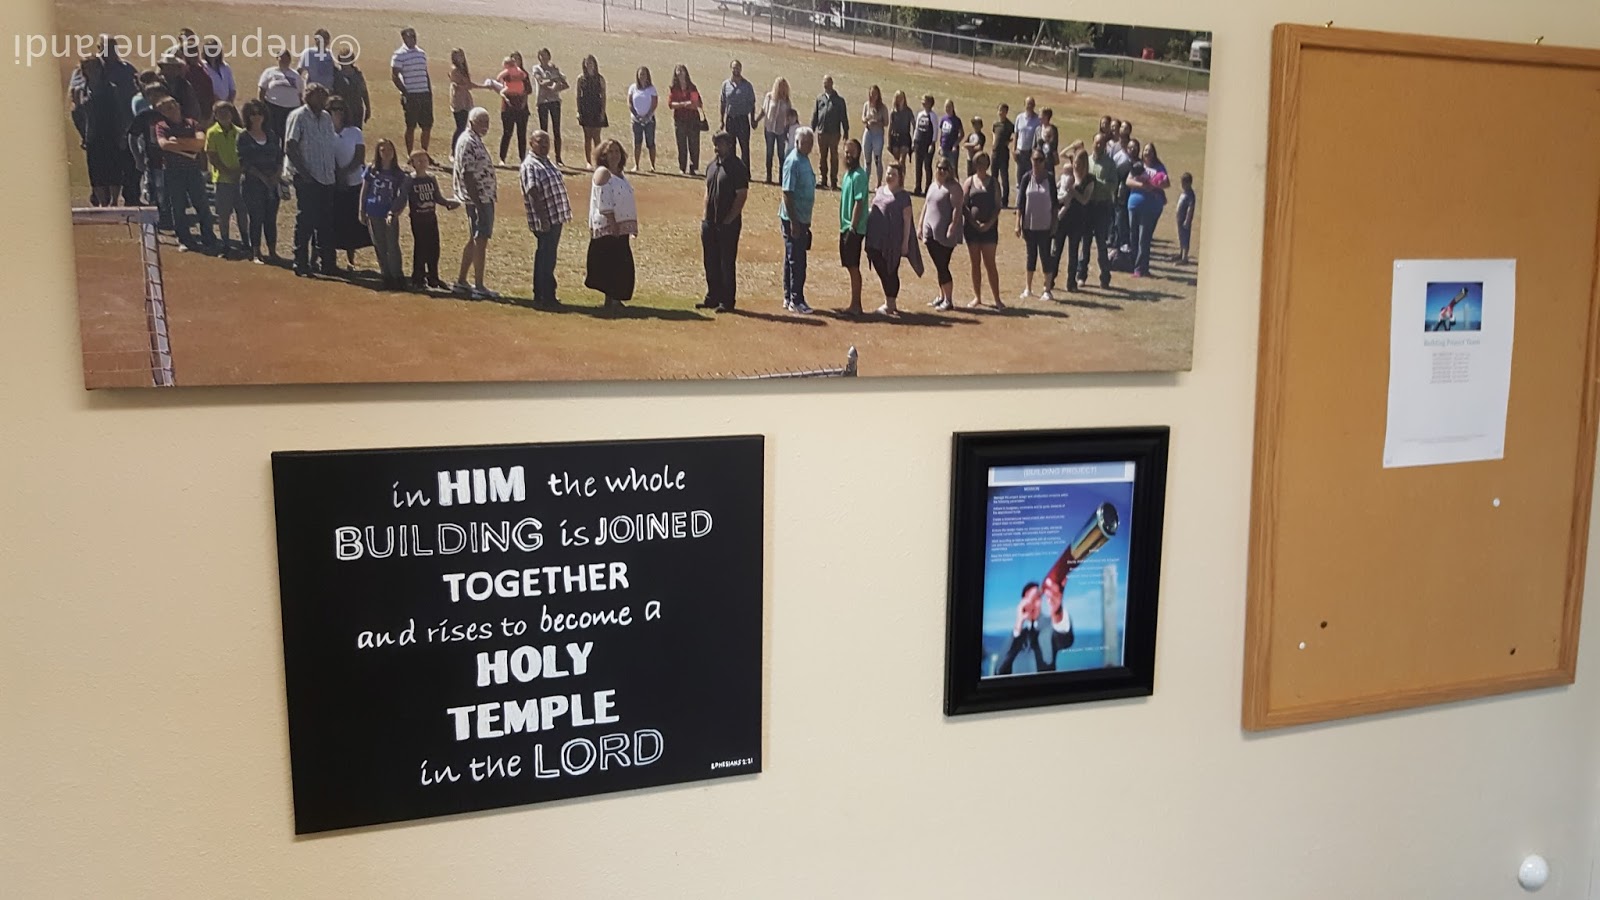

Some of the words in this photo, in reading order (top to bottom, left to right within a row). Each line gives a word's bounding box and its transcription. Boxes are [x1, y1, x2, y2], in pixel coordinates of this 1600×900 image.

[393, 481, 430, 508] in
[438, 466, 525, 506] HIM
[548, 472, 596, 497] the
[605, 465, 685, 492] whole
[335, 518, 543, 560] BUILDING
[560, 520, 589, 546] is
[595, 510, 712, 545] JOINED
[443, 562, 629, 602] TOGETHER
[358, 619, 416, 648] and
[428, 619, 492, 642] rises
[501, 618, 527, 636] to
[540, 605, 632, 632] become
[645, 601, 660, 621] a
[476, 642, 593, 687] HOLY
[447, 689, 619, 740] TEMPLE
[421, 760, 460, 785] in
[470, 756, 521, 781] the
[534, 728, 663, 778] LORD
